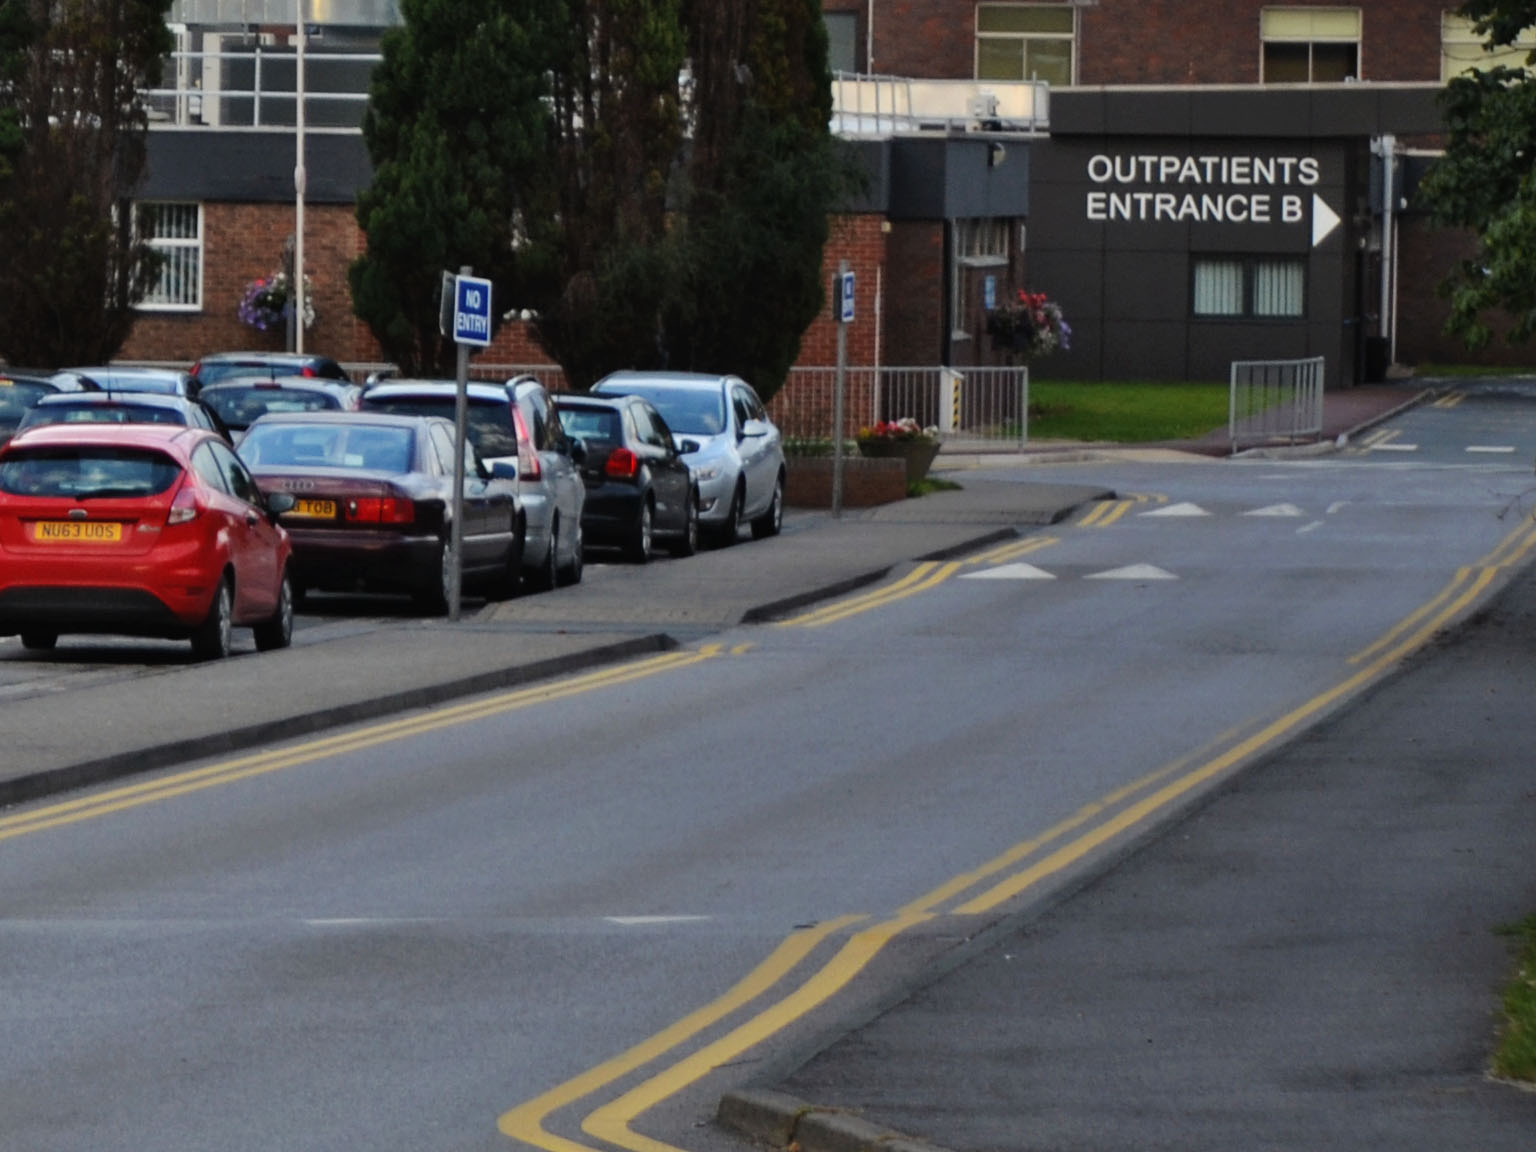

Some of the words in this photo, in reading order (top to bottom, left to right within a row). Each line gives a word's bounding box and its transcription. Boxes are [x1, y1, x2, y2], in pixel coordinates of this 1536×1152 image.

[1087, 154, 1320, 185] OUTPATIENTS
[1086, 192, 1271, 222] ENTRANCE
[1281, 195, 1303, 222] B
[465, 288, 481, 309] NO
[456, 312, 488, 334] ENTRY
[41, 524, 80, 537] NU63
